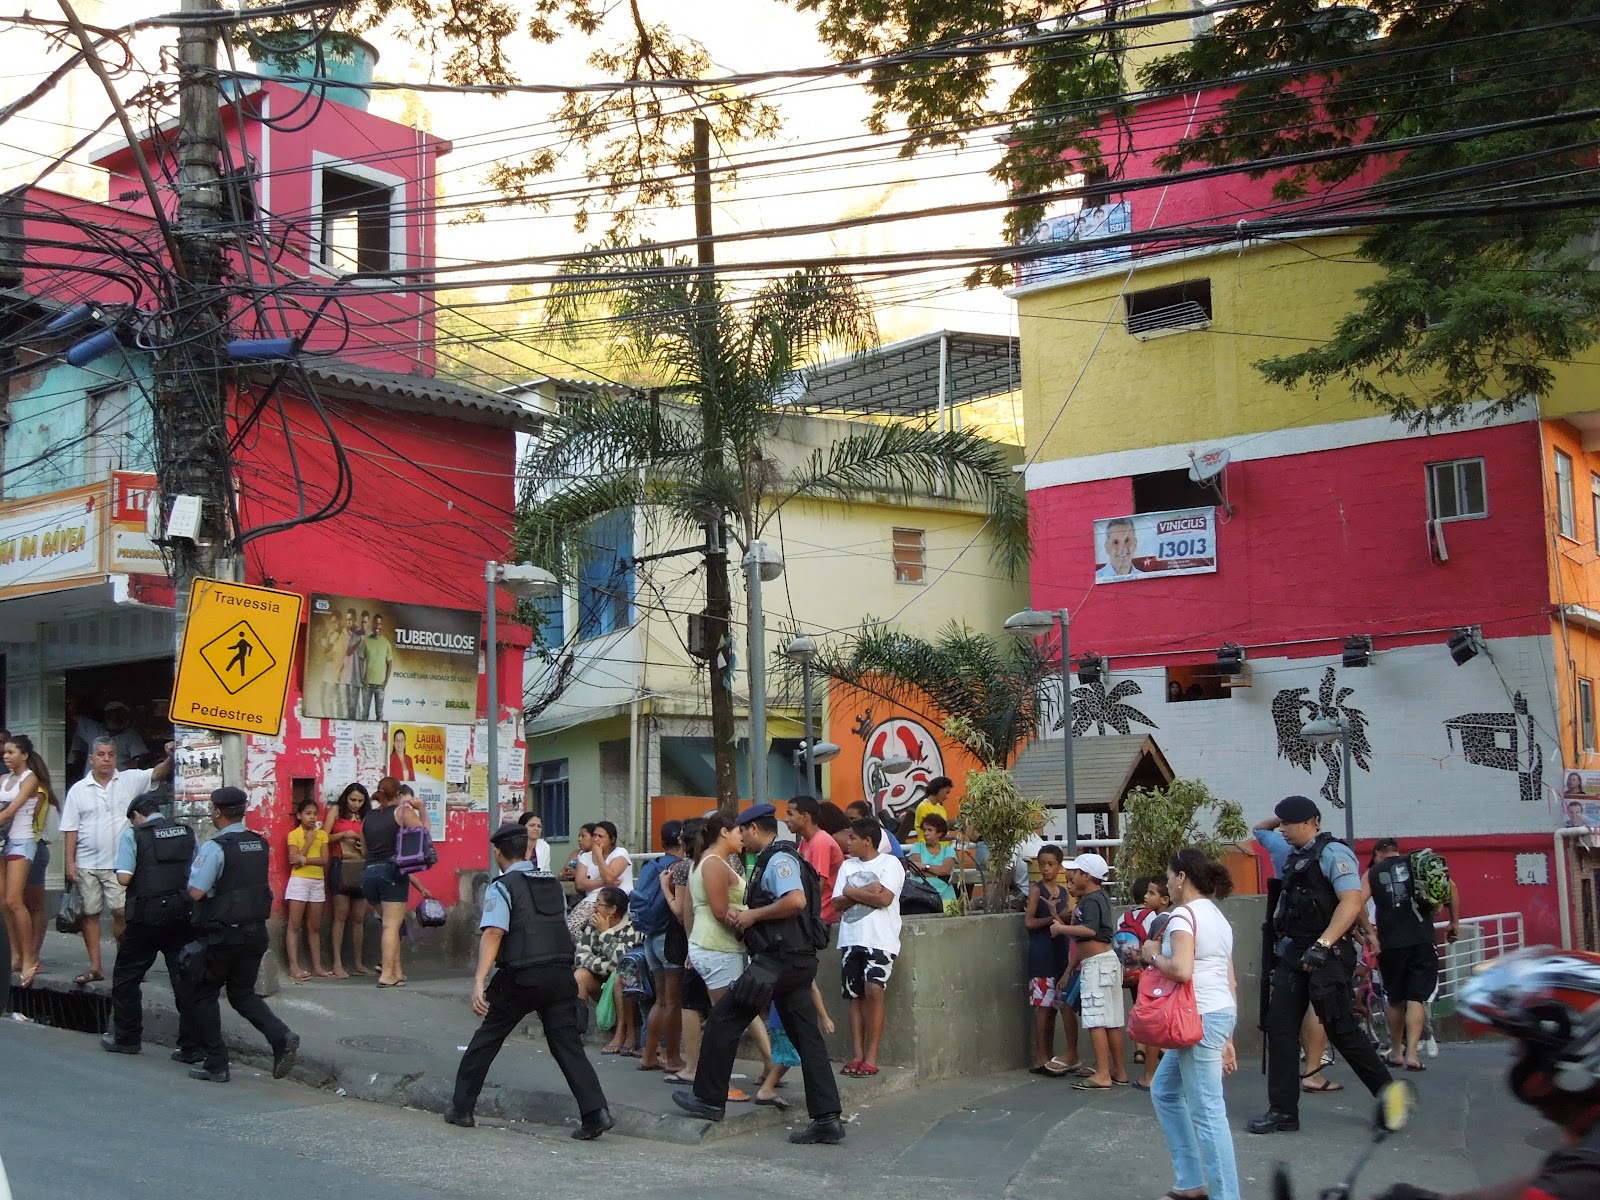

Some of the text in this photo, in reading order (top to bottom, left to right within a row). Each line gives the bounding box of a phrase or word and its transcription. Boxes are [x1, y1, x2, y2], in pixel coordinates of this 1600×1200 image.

[1202, 451, 1222, 462] SKY
[1160, 517, 1205, 532] VINICIUS
[20, 534, 38, 561] DA
[41, 523, 86, 558] GÁVEA
[1158, 537, 1207, 559] 13013
[214, 591, 280, 613] Travessia
[395, 628, 475, 649] TUBERCULOSE
[446, 700, 470, 709] BRASIL
[191, 702, 263, 724] Pedestres
[416, 734, 442, 744] LAURA
[414, 742, 444, 751] CARNEIRO
[414, 755, 443, 765] 14014
[155, 828, 186, 838] POLÍCIA
[239, 843, 262, 851] POLÍCIA
[1527, 870, 1536, 883] 4
